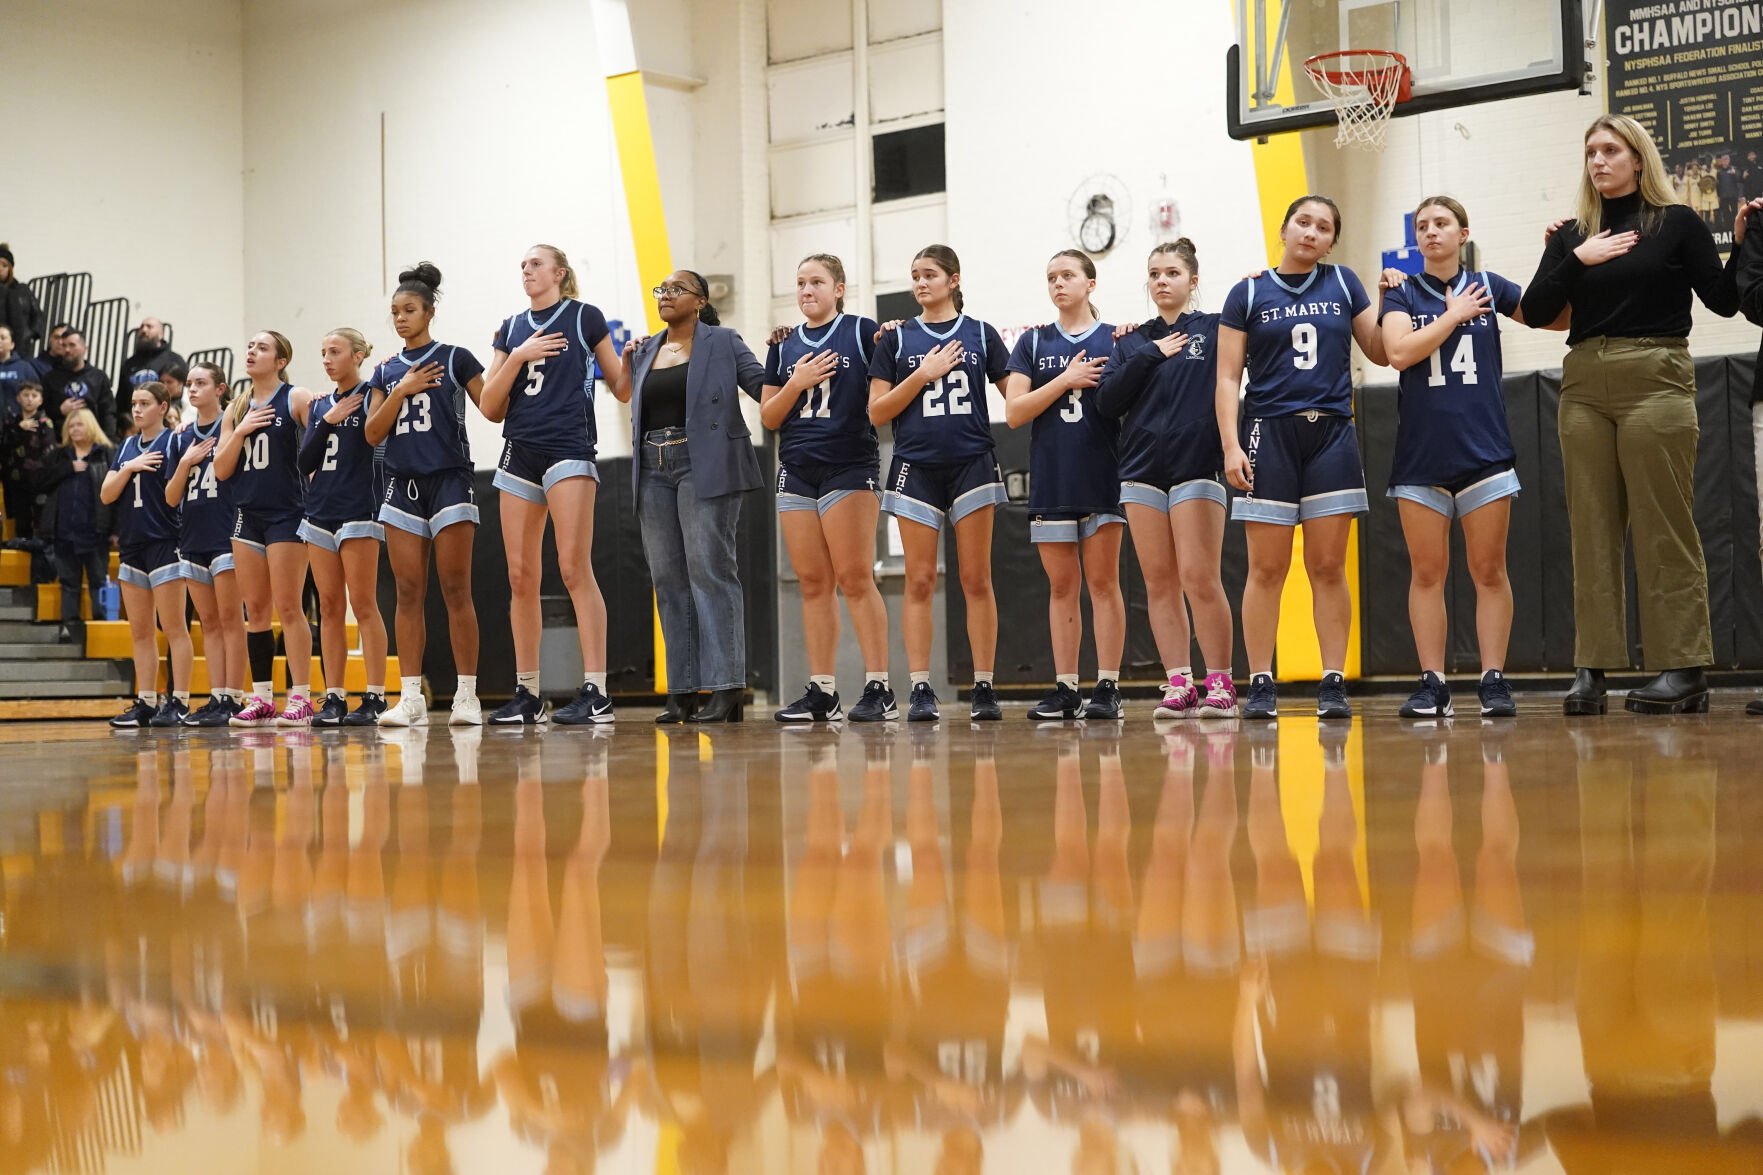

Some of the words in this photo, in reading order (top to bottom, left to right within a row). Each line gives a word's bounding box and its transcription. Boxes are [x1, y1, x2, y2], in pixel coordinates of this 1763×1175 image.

[1615, 3, 1763, 55] CHAMPION
[1630, 3, 1676, 21] MMHSAA
[1680, 0, 1701, 13] AND
[1624, 54, 1671, 71] NYSPHSAA
[1673, 45, 1726, 63] FEDERATION
[1261, 307, 1282, 324] ST.
[1285, 301, 1341, 316] MARY'S
[1039, 355, 1056, 370] ST.
[1291, 323, 1318, 370] 9
[1428, 334, 1478, 387] 14
[524, 357, 546, 396] 5
[923, 370, 972, 417] 22
[395, 392, 432, 436] 23
[800, 377, 831, 418] 11
[1060, 388, 1083, 423] 3
[243, 432, 270, 472] 10
[322, 433, 339, 471] 2
[133, 472, 143, 508] 1
[187, 461, 218, 502] 24
